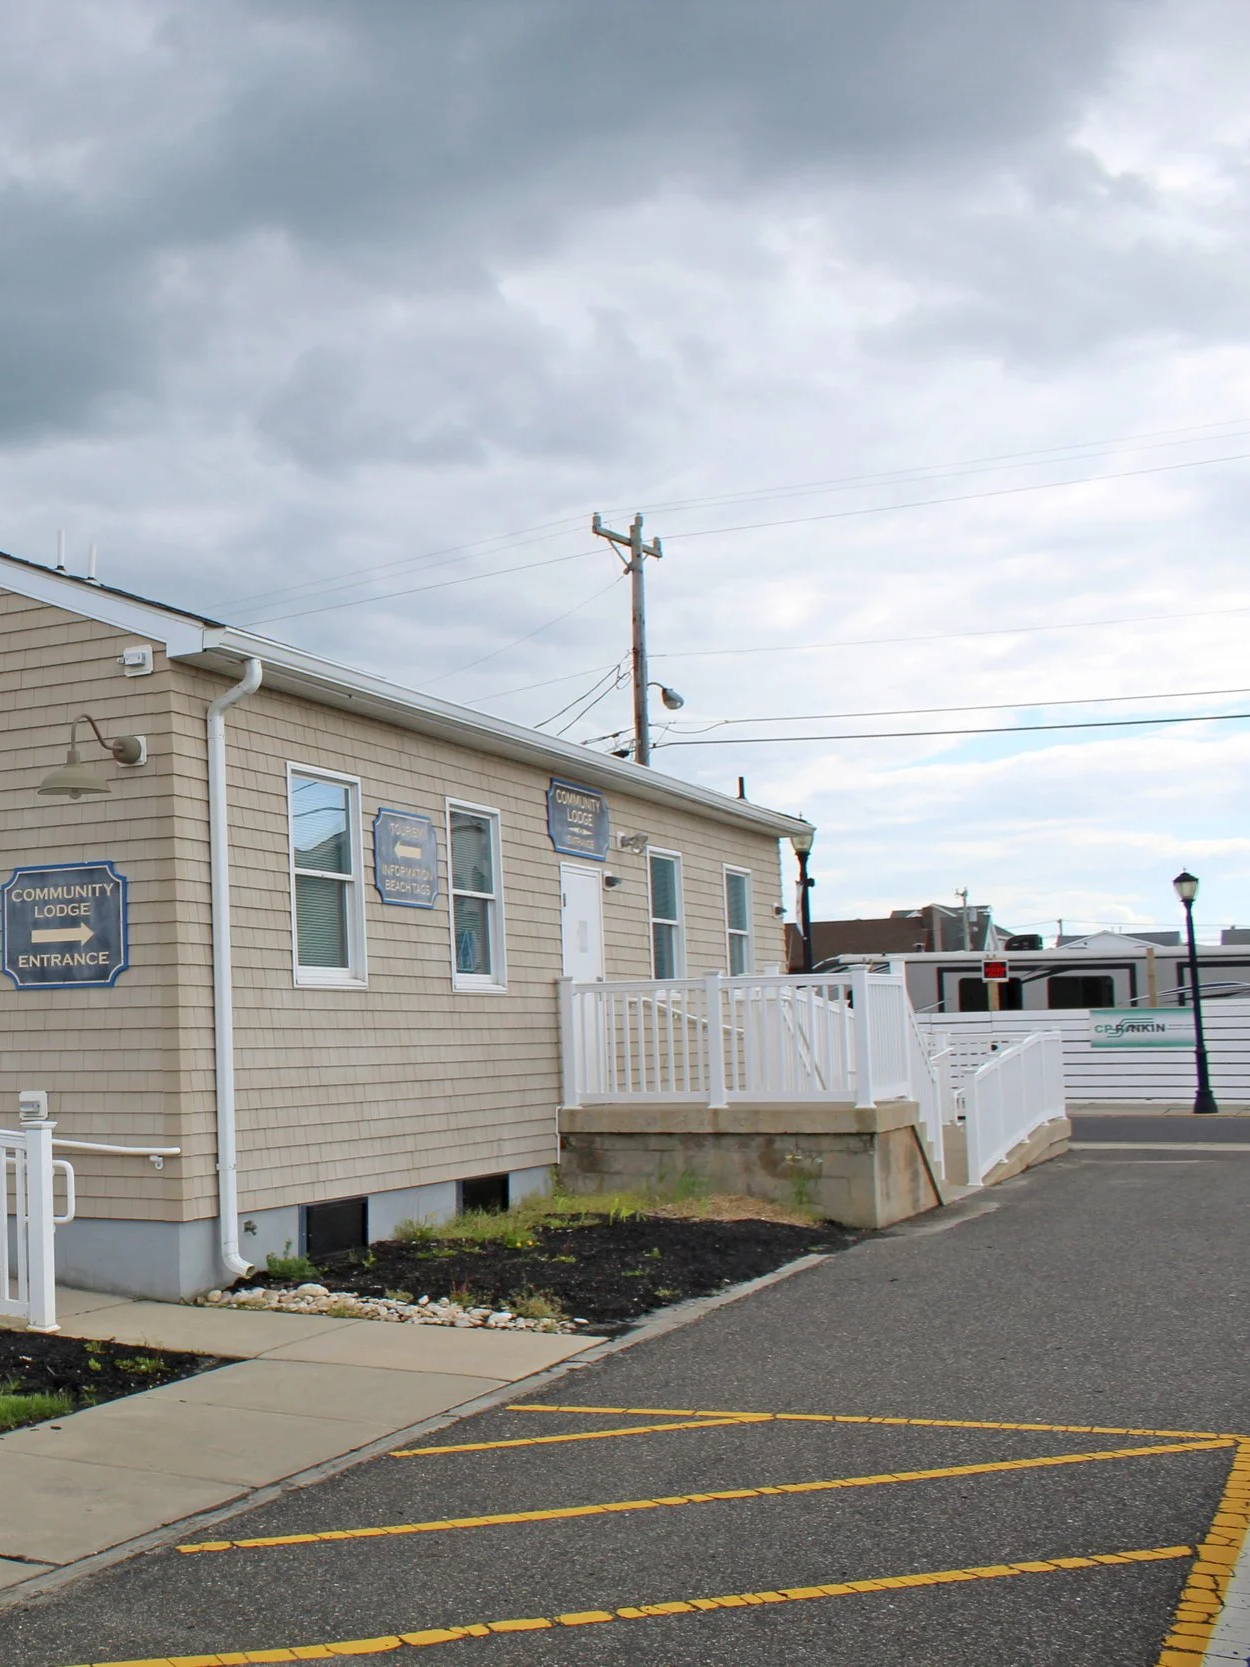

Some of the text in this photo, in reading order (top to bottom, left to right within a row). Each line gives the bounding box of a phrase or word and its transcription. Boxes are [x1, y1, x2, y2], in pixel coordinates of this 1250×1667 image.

[556, 789, 600, 813] COMMUNITY
[567, 808, 593, 827] LODGE
[382, 863, 432, 881] INFORMATION
[11, 883, 114, 902] COMMUNITY
[385, 879, 431, 896] BEACH TAGS
[34, 903, 91, 918] LODGE
[18, 951, 110, 968] ENTRANCE
